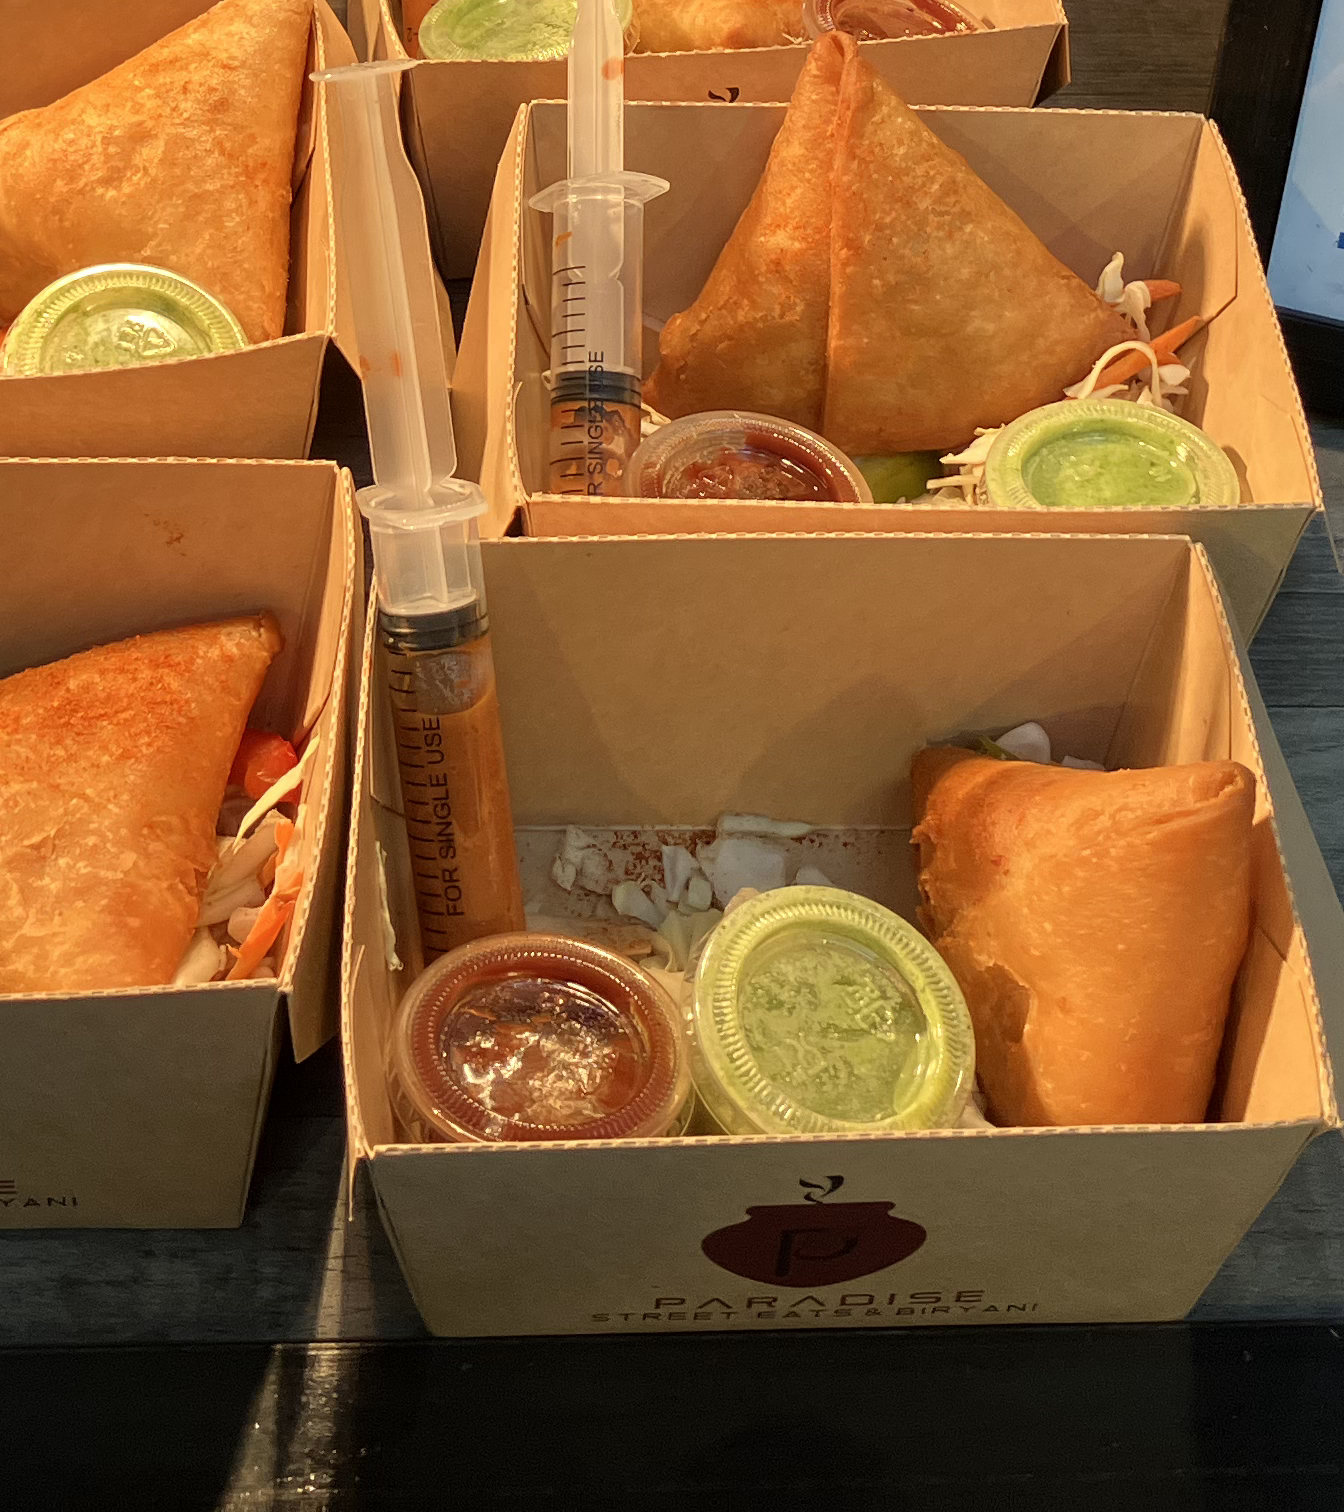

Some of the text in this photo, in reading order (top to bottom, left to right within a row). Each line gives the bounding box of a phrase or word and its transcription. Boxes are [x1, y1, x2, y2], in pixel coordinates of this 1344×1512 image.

[421, 716, 466, 917] FOR SINGLE USE
[653, 1289, 987, 1310] PARADISE
[591, 1311, 739, 1322] STREET
